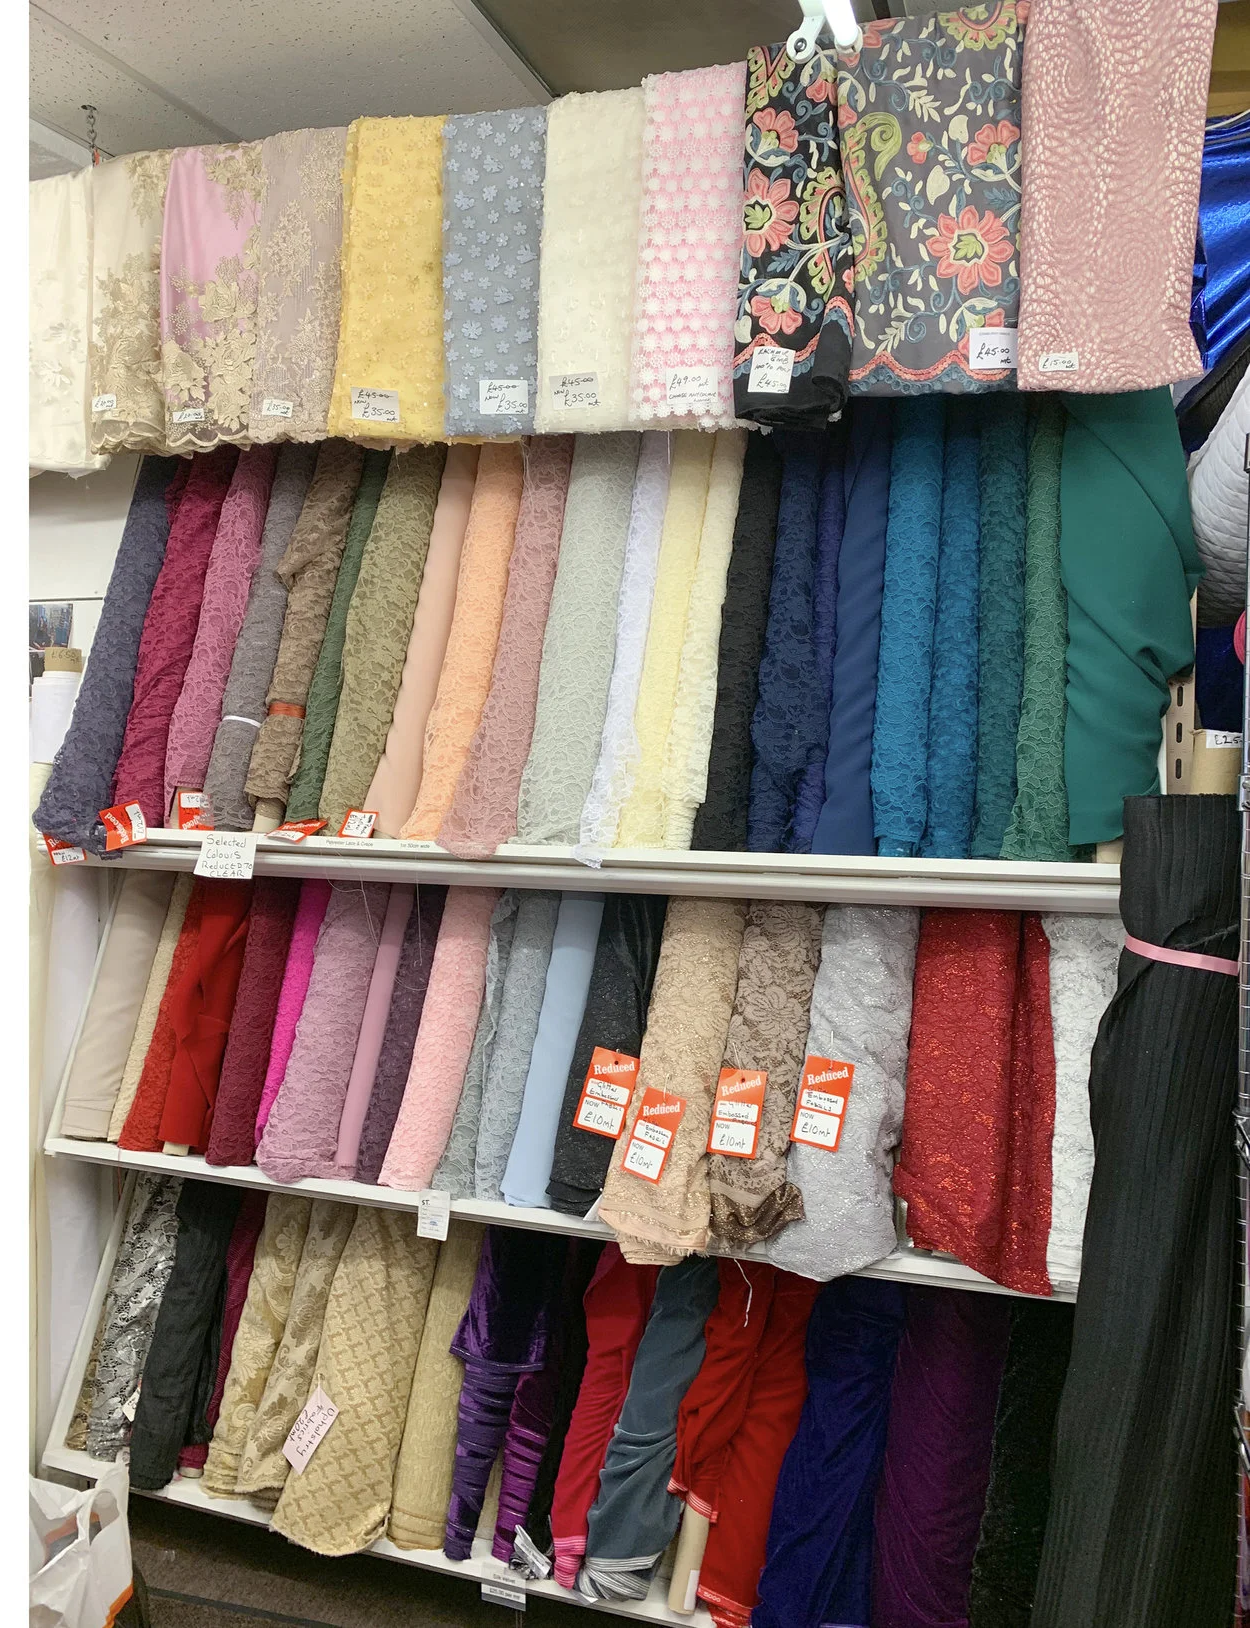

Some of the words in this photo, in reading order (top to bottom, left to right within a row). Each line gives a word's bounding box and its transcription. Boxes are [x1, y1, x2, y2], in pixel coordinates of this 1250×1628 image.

[976, 343, 1010, 359] £45.00
[495, 393, 527, 412] £35.00
[564, 390, 597, 407] £35.00
[362, 402, 395, 418] £35.00
[104, 812, 129, 844] Reduced
[206, 834, 247, 848] Selected
[209, 870, 245, 878] CLEAR
[593, 1061, 636, 1075] Reduced
[806, 1066, 849, 1086] Reduced
[721, 1075, 762, 1097] Reduced
[585, 1099, 600, 1108] NOW
[643, 1101, 681, 1116] Reduced
[799, 1111, 814, 1120] NOW
[715, 1122, 730, 1130] NOW
[632, 1141, 645, 1150] NOW
